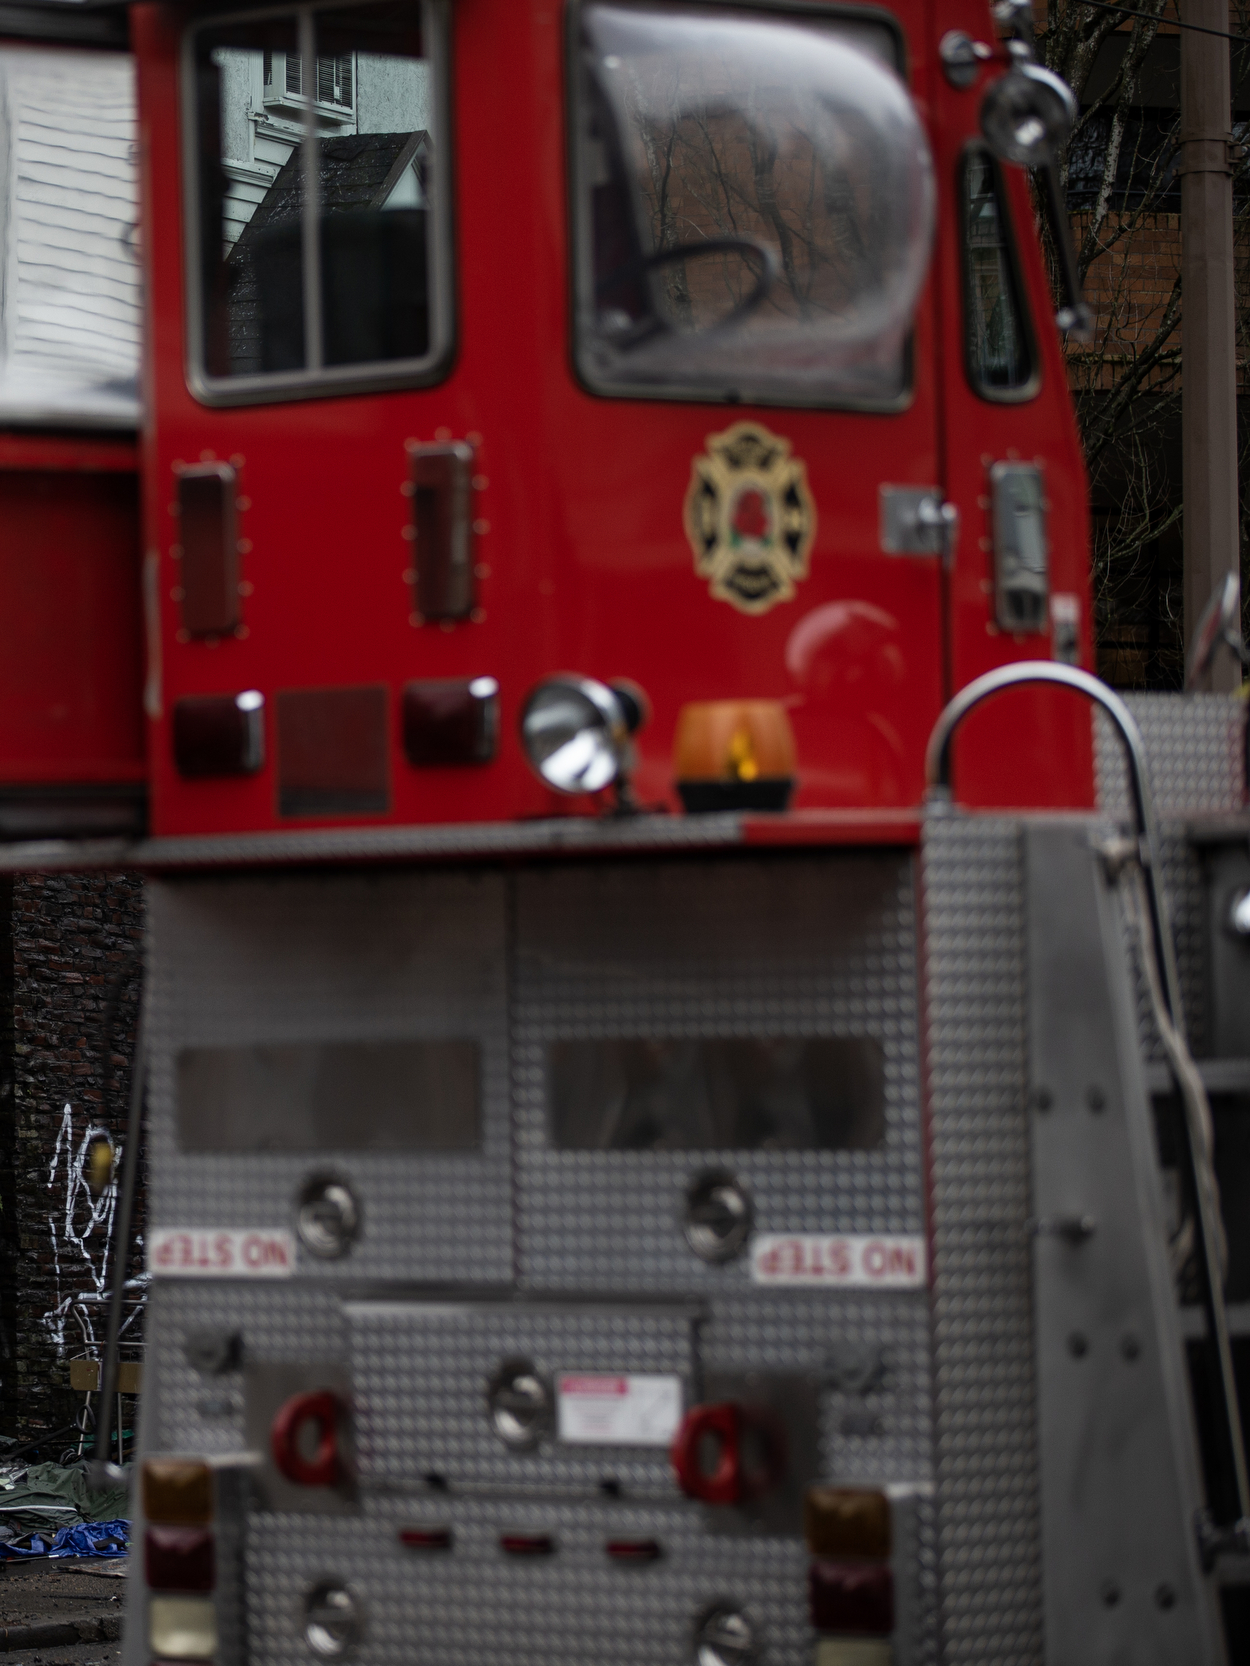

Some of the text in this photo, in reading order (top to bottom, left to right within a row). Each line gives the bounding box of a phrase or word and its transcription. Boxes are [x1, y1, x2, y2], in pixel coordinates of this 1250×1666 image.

[155, 1234, 289, 1268] NO STEP
[756, 1240, 916, 1277] NO STEP
